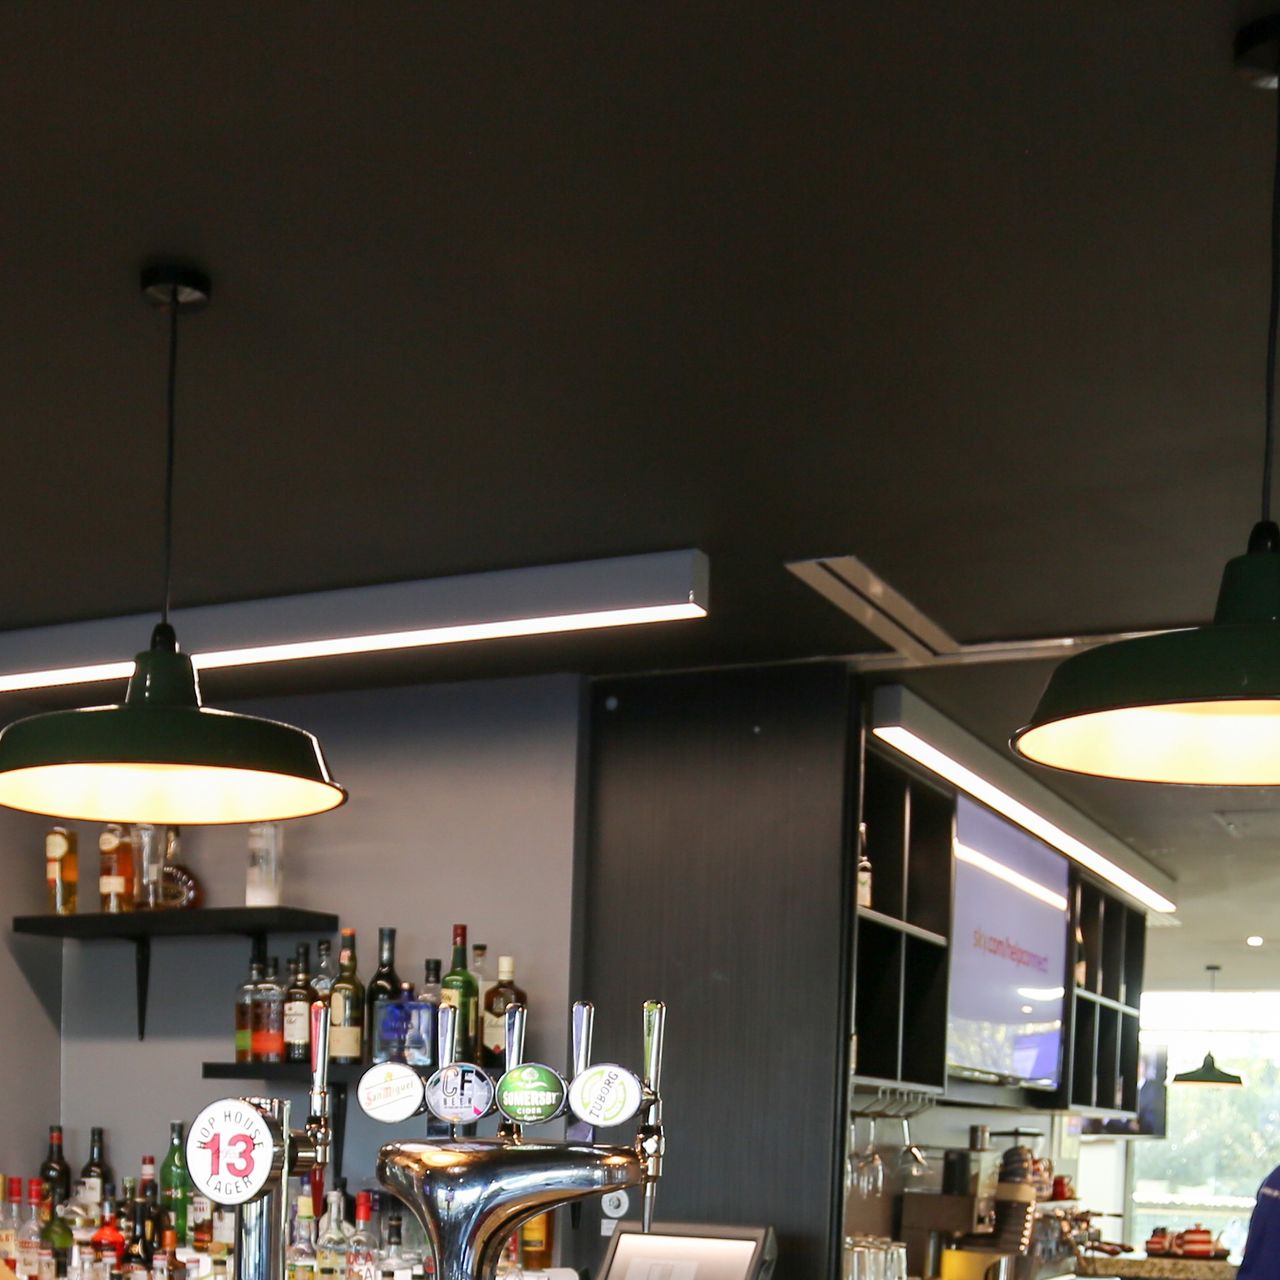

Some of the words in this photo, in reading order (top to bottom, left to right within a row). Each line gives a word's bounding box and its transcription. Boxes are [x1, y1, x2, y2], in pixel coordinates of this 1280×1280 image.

[503, 1090, 557, 1106] SOMERSBY
[589, 1071, 619, 1119] TUBORG
[196, 1116, 216, 1150] HOP
[223, 1110, 264, 1150] HOUSE
[205, 1132, 255, 1178] 13
[206, 1174, 253, 1195] LAGER
